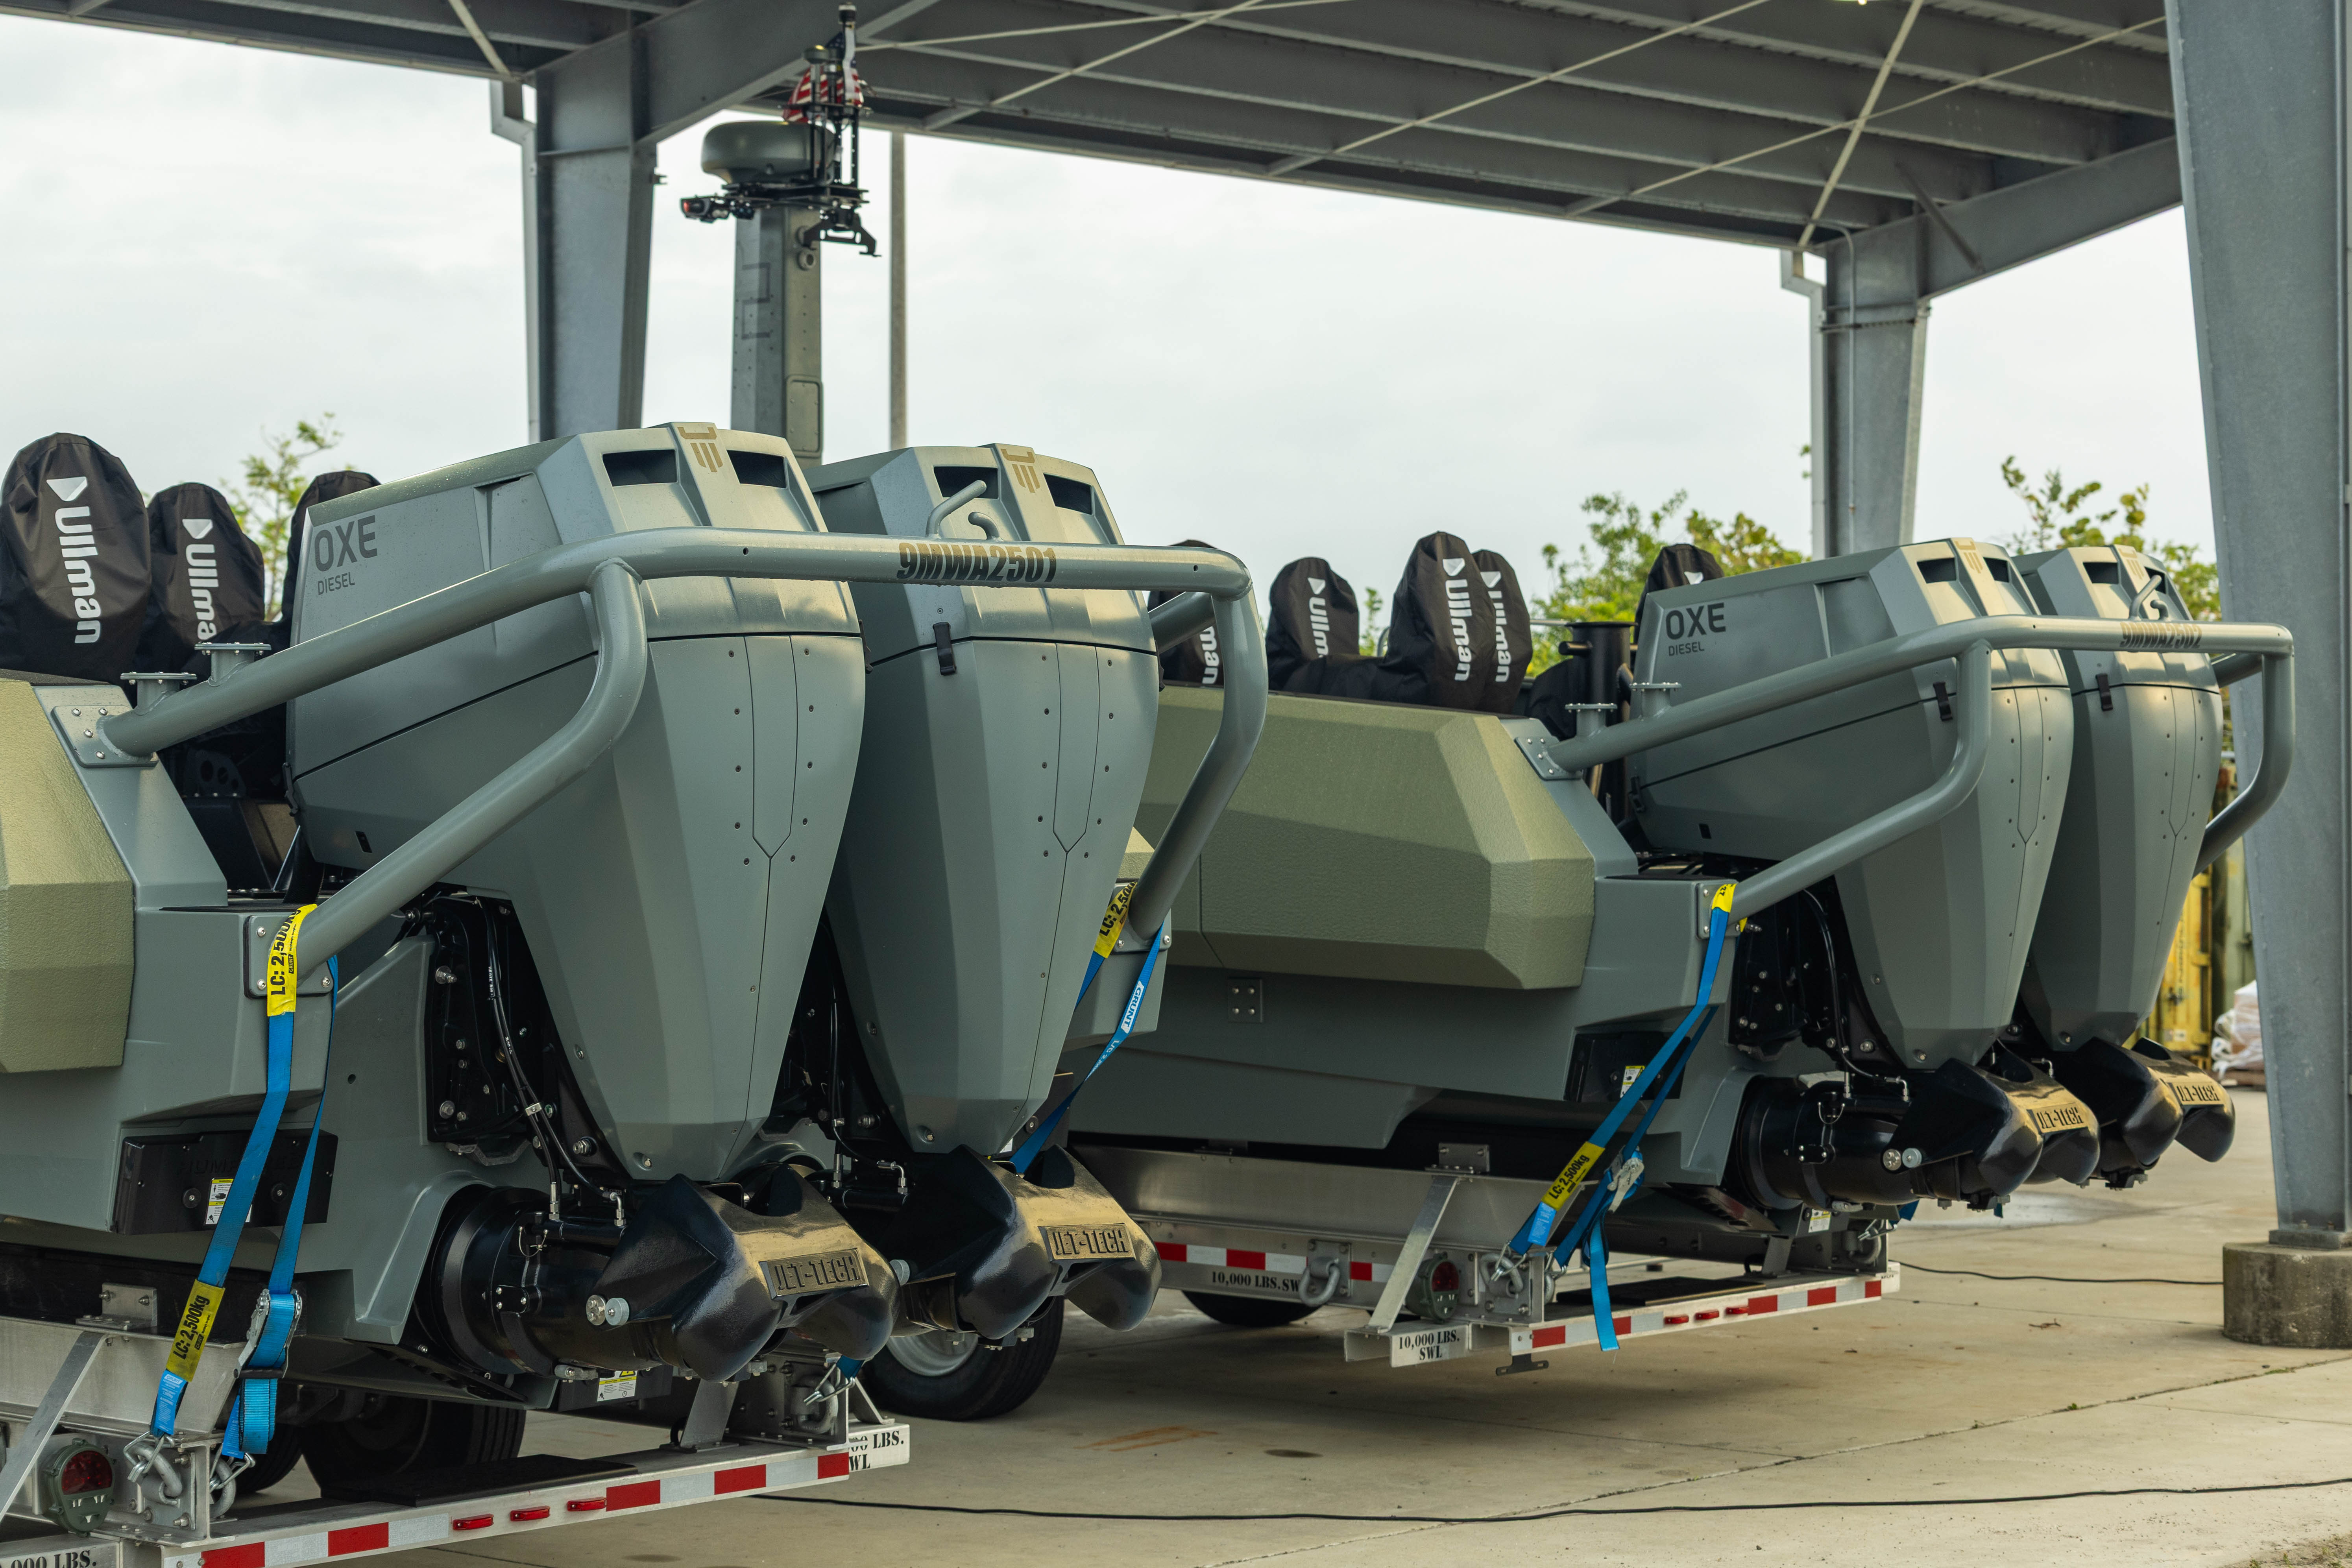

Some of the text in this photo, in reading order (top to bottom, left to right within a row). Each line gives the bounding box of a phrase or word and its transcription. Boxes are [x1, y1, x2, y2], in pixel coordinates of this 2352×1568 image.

[314, 515, 378, 572] OXE
[55, 506, 101, 644] Ullman
[896, 543, 1057, 583] 9MWA2501
[186, 544, 219, 640] Ullma
[318, 572, 355, 595] DIESEL
[1309, 597, 1330, 655] Ullm
[1445, 579, 1473, 681] Ullman
[1666, 602, 1726, 640] OXE
[2120, 622, 2202, 648] 9MWA2502
[1200, 626, 1219, 684] man
[1668, 641, 1705, 657] DIESEL
[1099, 914, 1117, 936] LC:
[270, 970, 286, 995] LC:
[1124, 987, 1141, 1028] GRUNT
[2176, 1085, 2220, 1102] JET-TECH
[2036, 1107, 2084, 1129] JET-TECH
[1549, 1185, 1565, 1200] LC:
[1559, 1154, 1590, 1186] 2,500kg
[1053, 1229, 1129, 1255] JET-TECH
[775, 1256, 860, 1290] JET-TECH
[1212, 1271, 1300, 1292] 10,000 LBS. SW
[173, 1295, 210, 1360] LC: 2,500kg
[1399, 1330, 1460, 1350] 10,000 LBS.
[1419, 1345, 1442, 1360] SWL
[872, 1431, 904, 1449] LBS.
[849, 1454, 870, 1471] WL
[54, 1550, 96, 1568] LBS.
